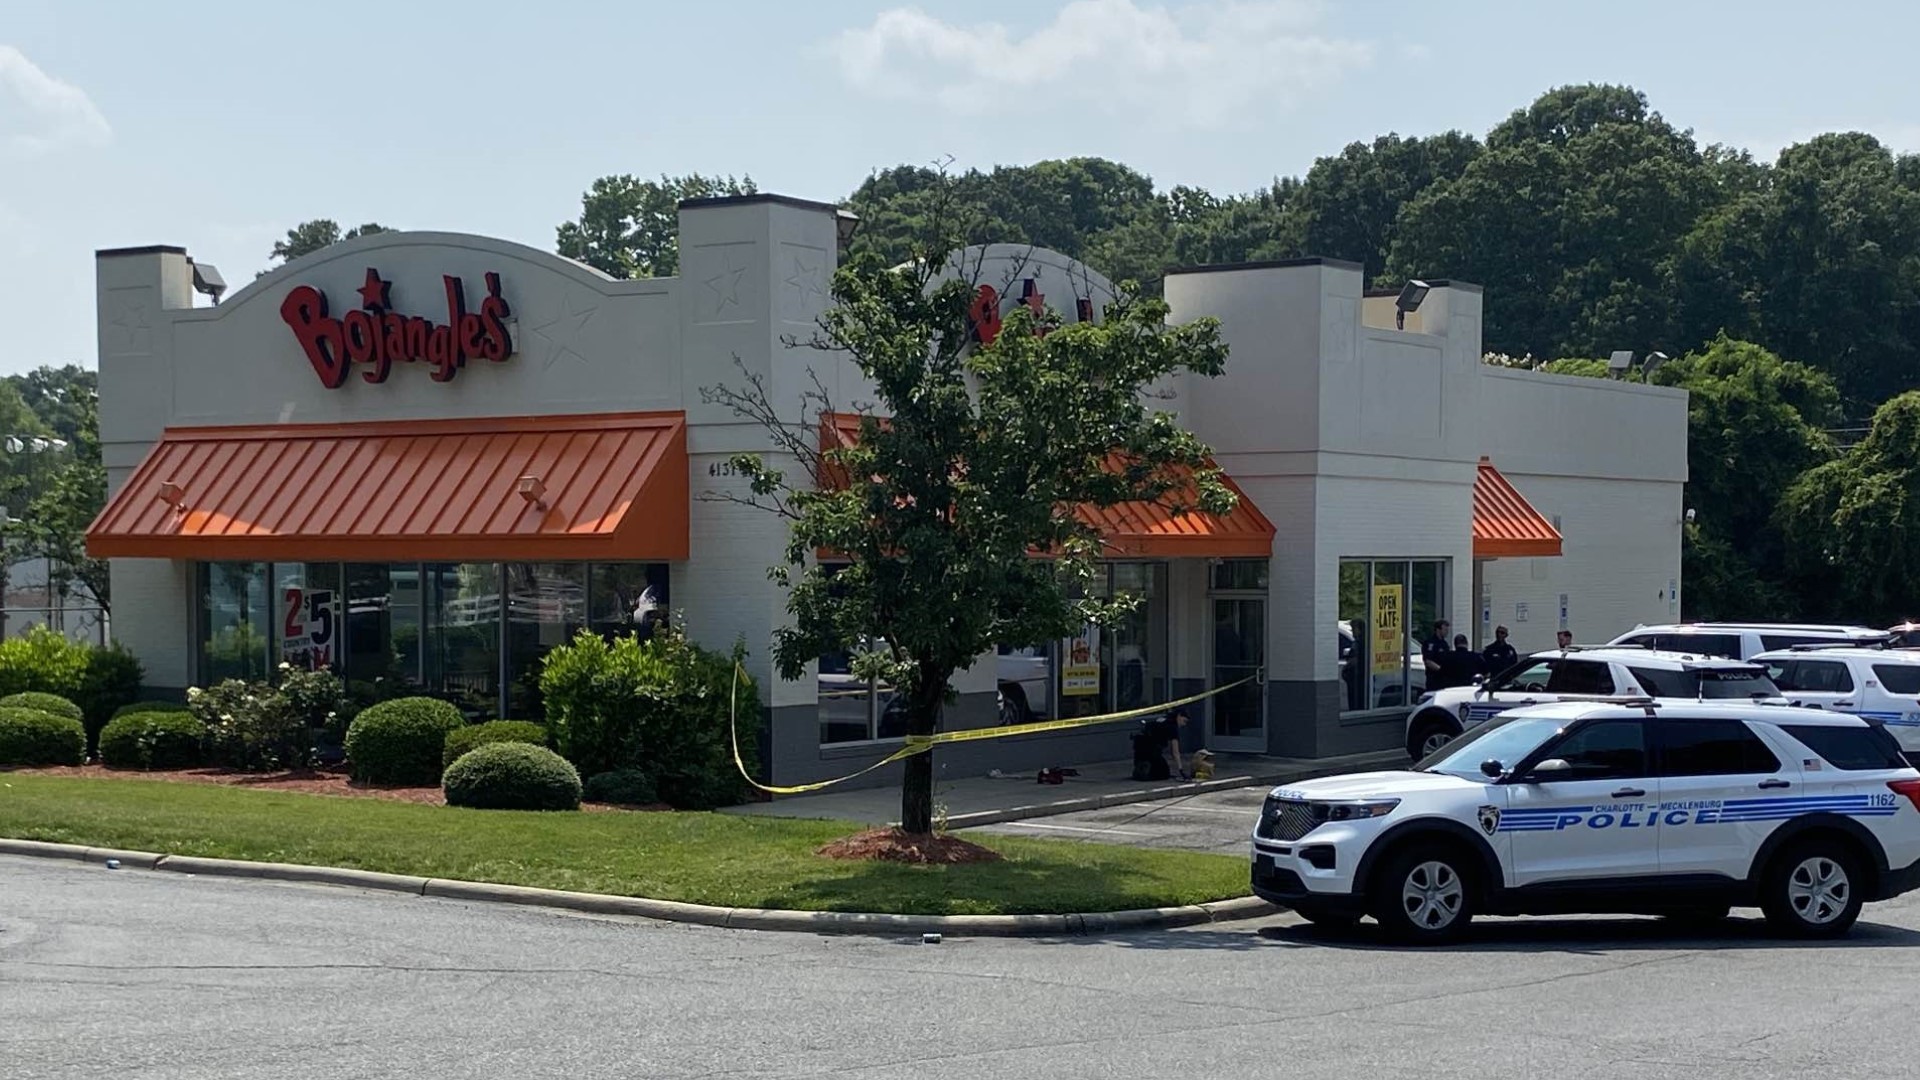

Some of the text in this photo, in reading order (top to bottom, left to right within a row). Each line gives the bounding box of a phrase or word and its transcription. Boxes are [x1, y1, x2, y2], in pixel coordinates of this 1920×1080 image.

[1378, 595, 1397, 610] OPEN
[285, 589, 304, 637] 2
[1378, 611, 1397, 628] LATE
[1594, 799, 1722, 814] CHARLOTTE MECKLENBURG
[1869, 793, 1897, 806] 1162
[1556, 809, 1720, 831] POLICE
